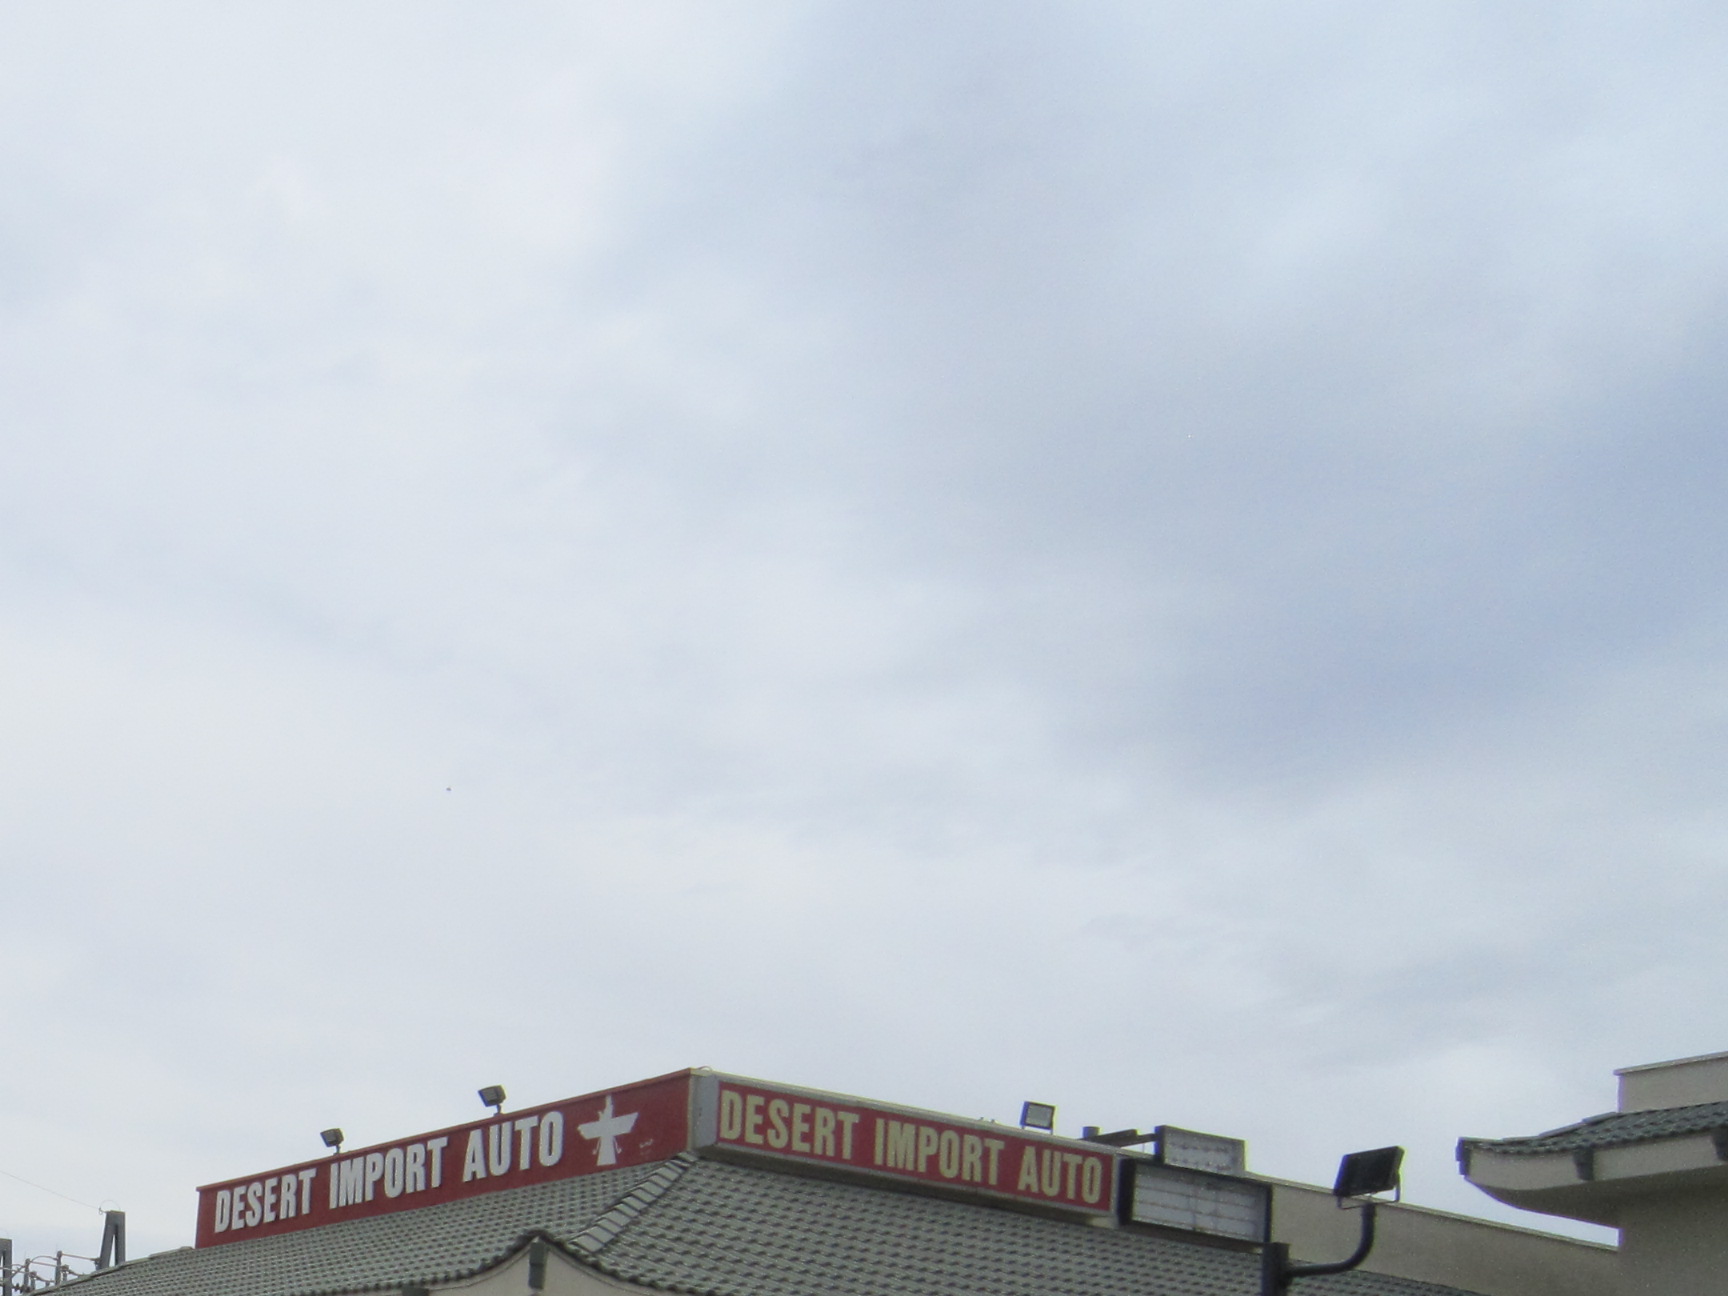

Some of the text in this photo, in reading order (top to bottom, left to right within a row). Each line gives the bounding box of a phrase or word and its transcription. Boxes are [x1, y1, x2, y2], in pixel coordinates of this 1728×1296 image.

[214, 1110, 565, 1234] DESERT IMPORT AUTO
[719, 1089, 1103, 1205] DESERT IMPORT AUTO
